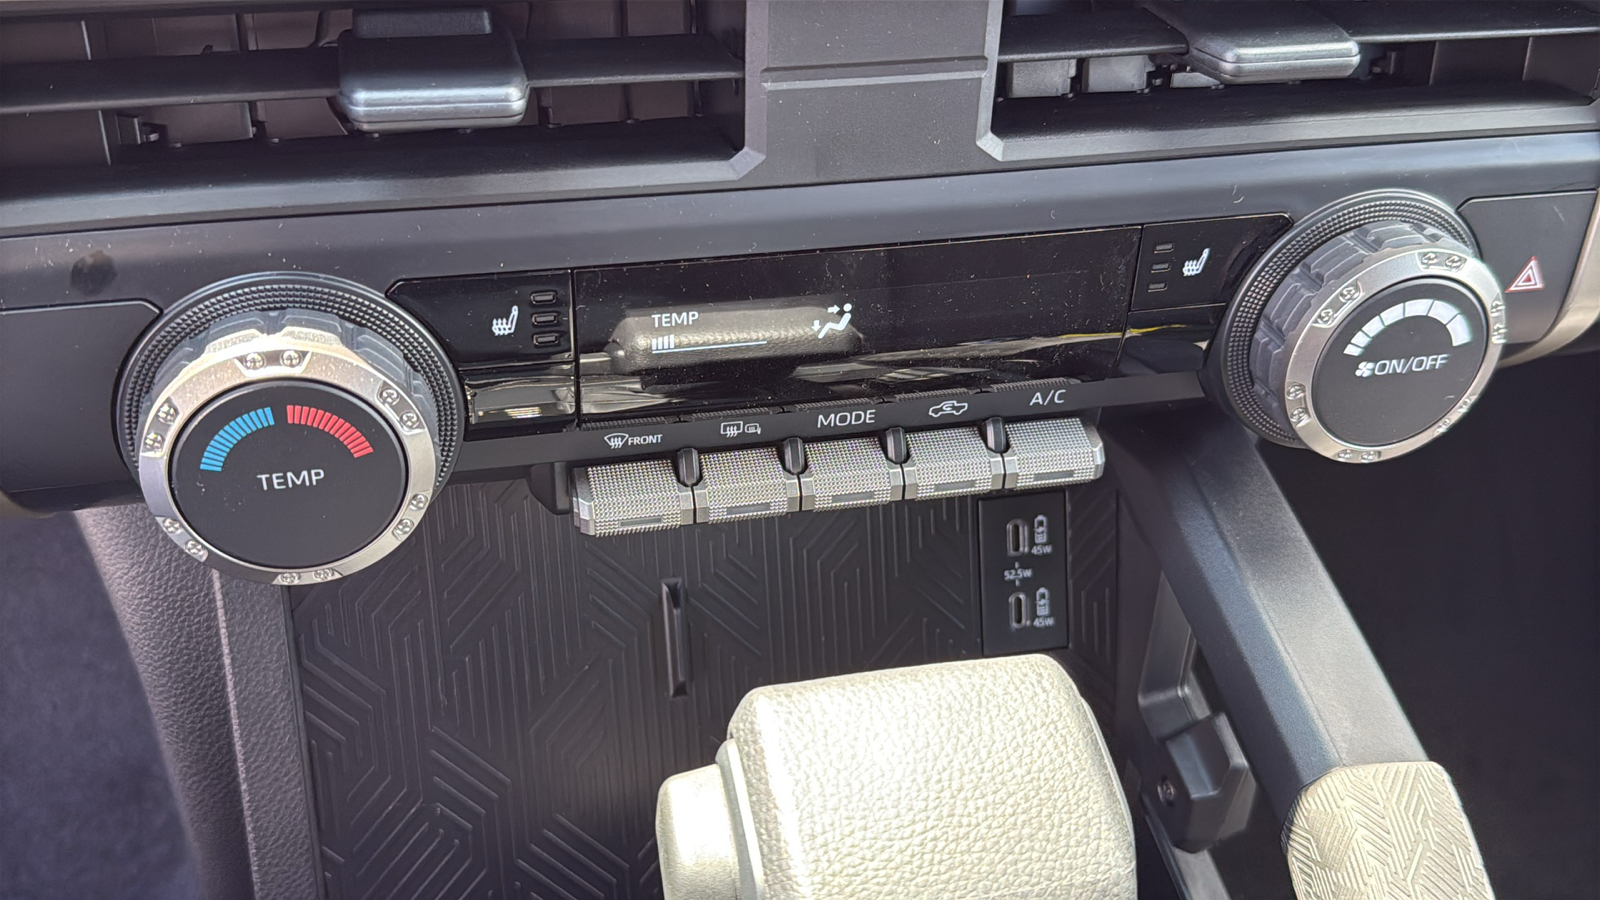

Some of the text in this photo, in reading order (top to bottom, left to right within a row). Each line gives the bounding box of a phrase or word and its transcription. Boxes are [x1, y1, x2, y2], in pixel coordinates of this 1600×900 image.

[651, 310, 699, 328] TEMP
[1374, 354, 1449, 376] ON/OFF
[1029, 389, 1066, 406] A/C
[817, 409, 876, 428] MODE
[627, 433, 663, 446] FRONT
[256, 468, 325, 491] TEMP
[1031, 544, 1052, 555] 45W
[1004, 568, 1032, 580] 52.5W
[1033, 617, 1055, 628] 45W
